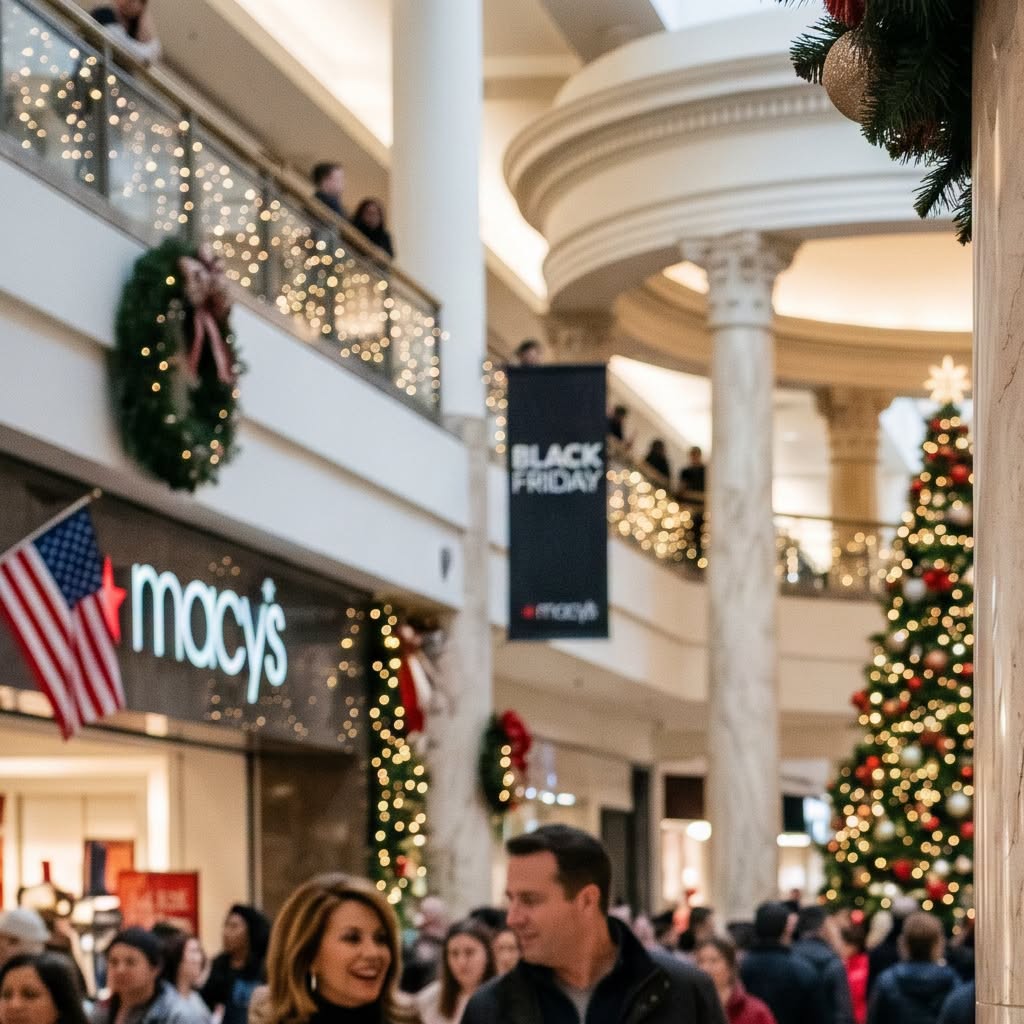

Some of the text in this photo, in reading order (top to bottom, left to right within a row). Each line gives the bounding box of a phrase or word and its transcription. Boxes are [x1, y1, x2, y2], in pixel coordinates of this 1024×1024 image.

[511, 443, 603, 469] BLACK
[511, 468, 603, 494] FRIDAY
[131, 563, 288, 704] macy's
